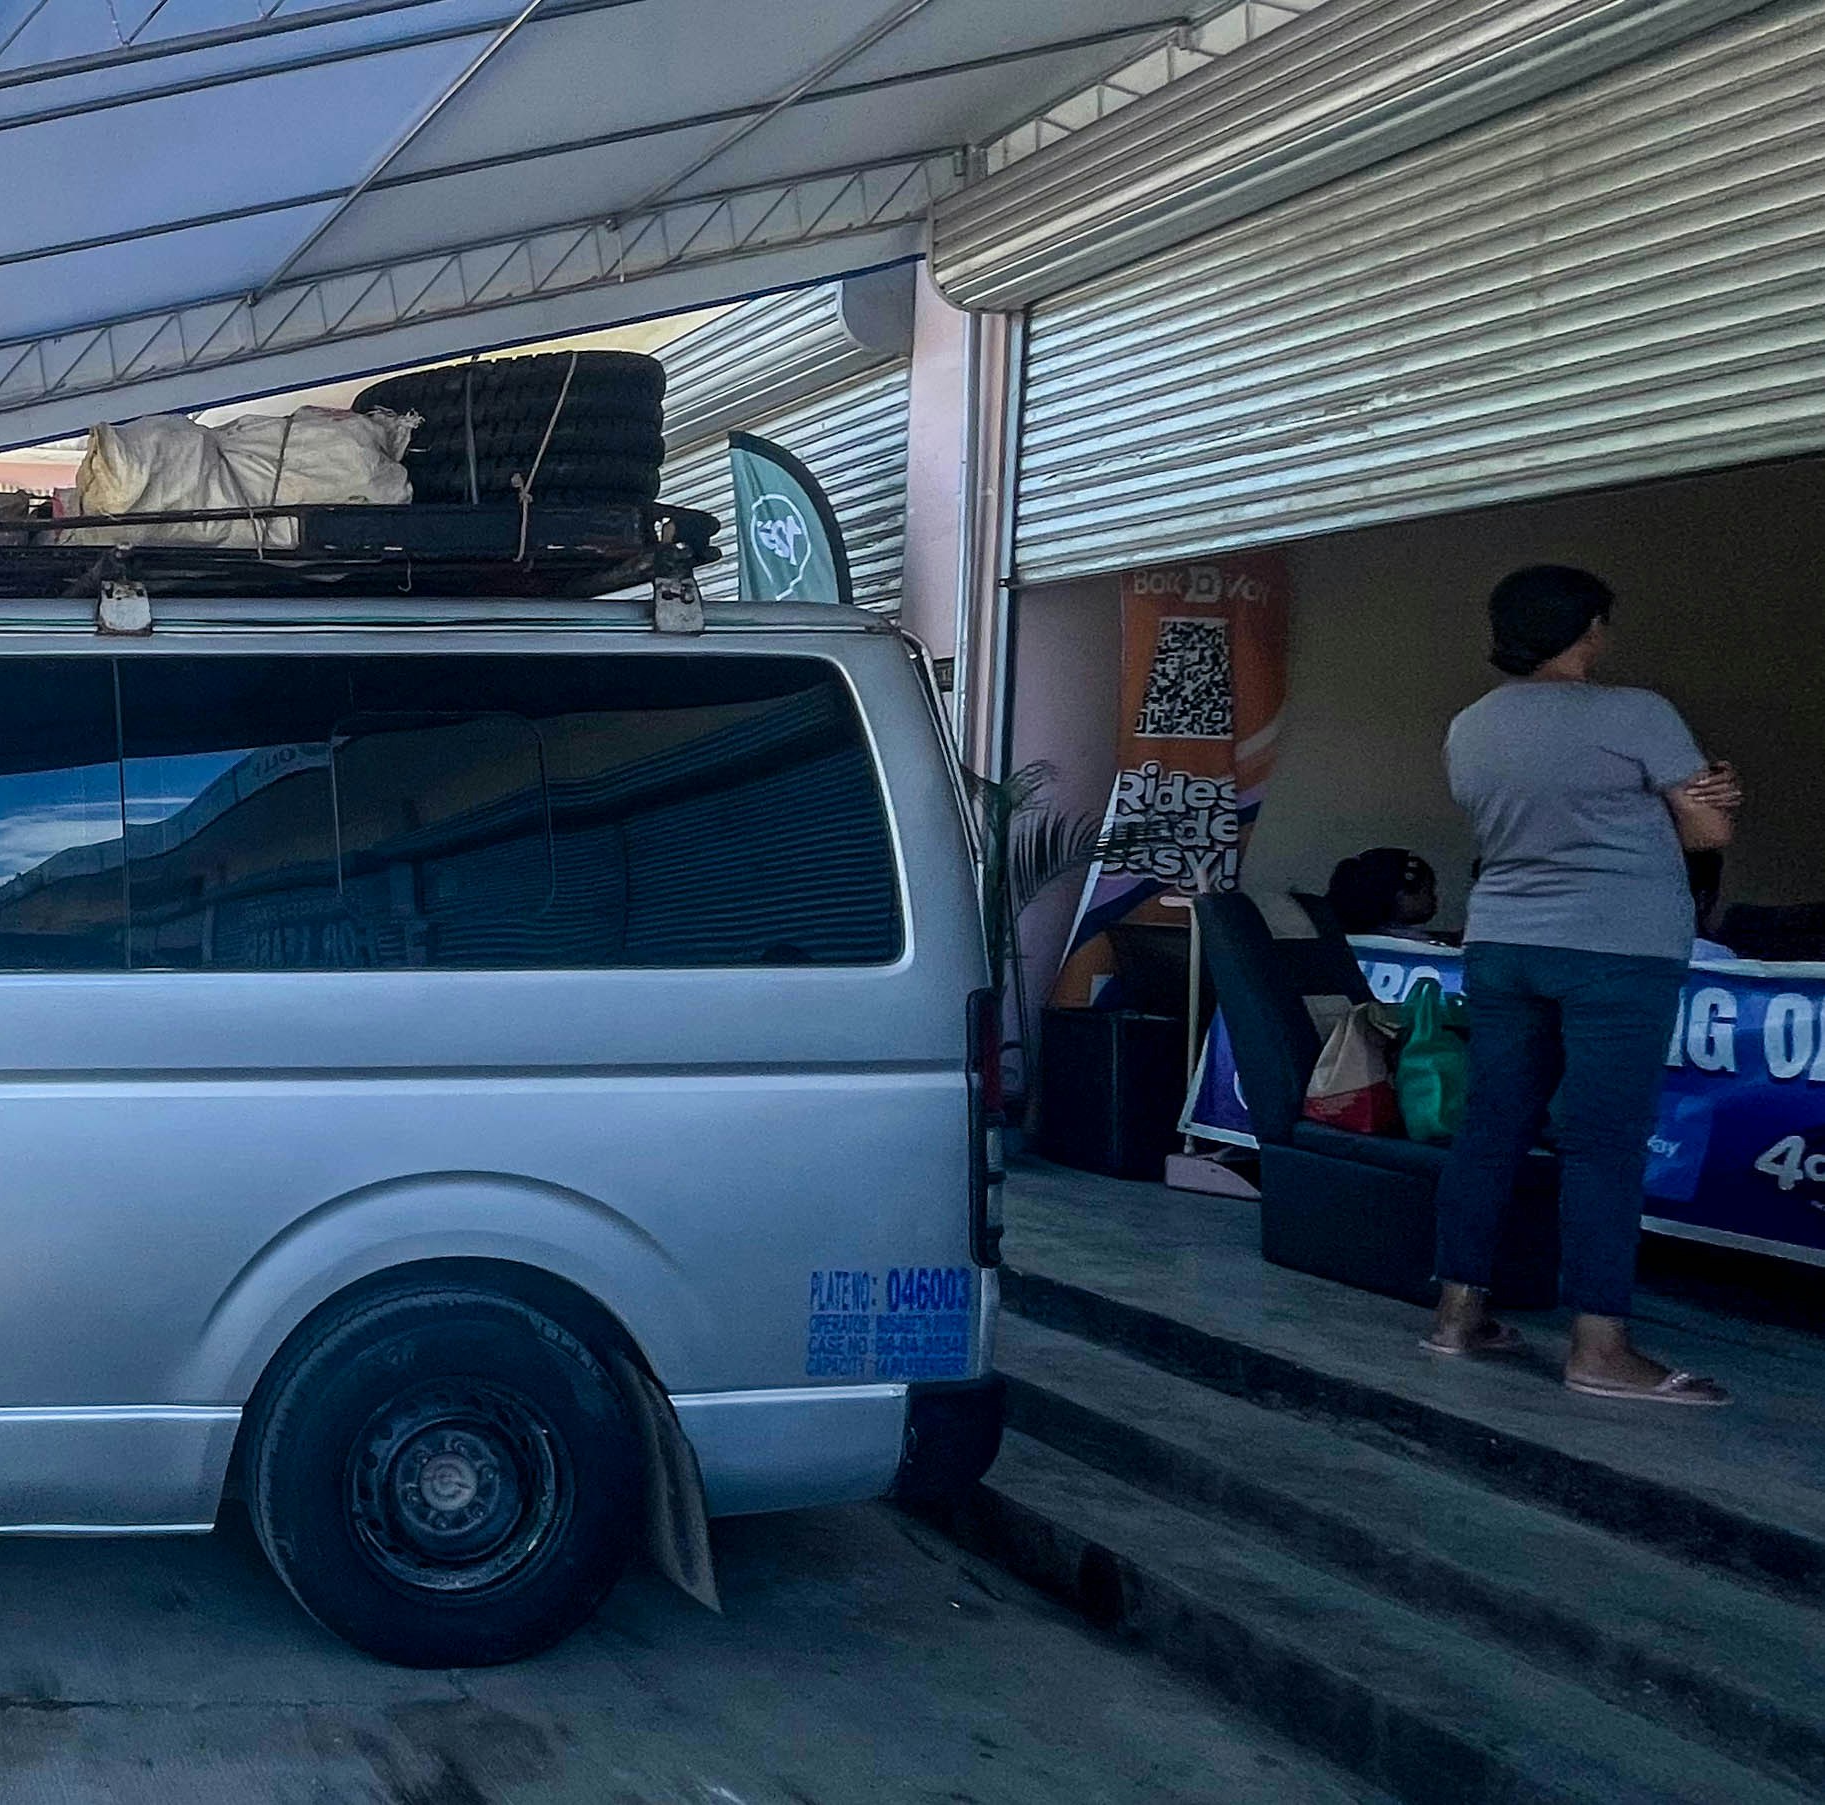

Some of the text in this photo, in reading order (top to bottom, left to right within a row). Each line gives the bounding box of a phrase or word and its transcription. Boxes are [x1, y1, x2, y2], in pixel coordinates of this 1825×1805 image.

[1116, 763, 1237, 813] Rides
[810, 1270, 849, 1312] PLATE
[887, 1266, 972, 1313] 046003
[808, 1335, 845, 1356] CASE
